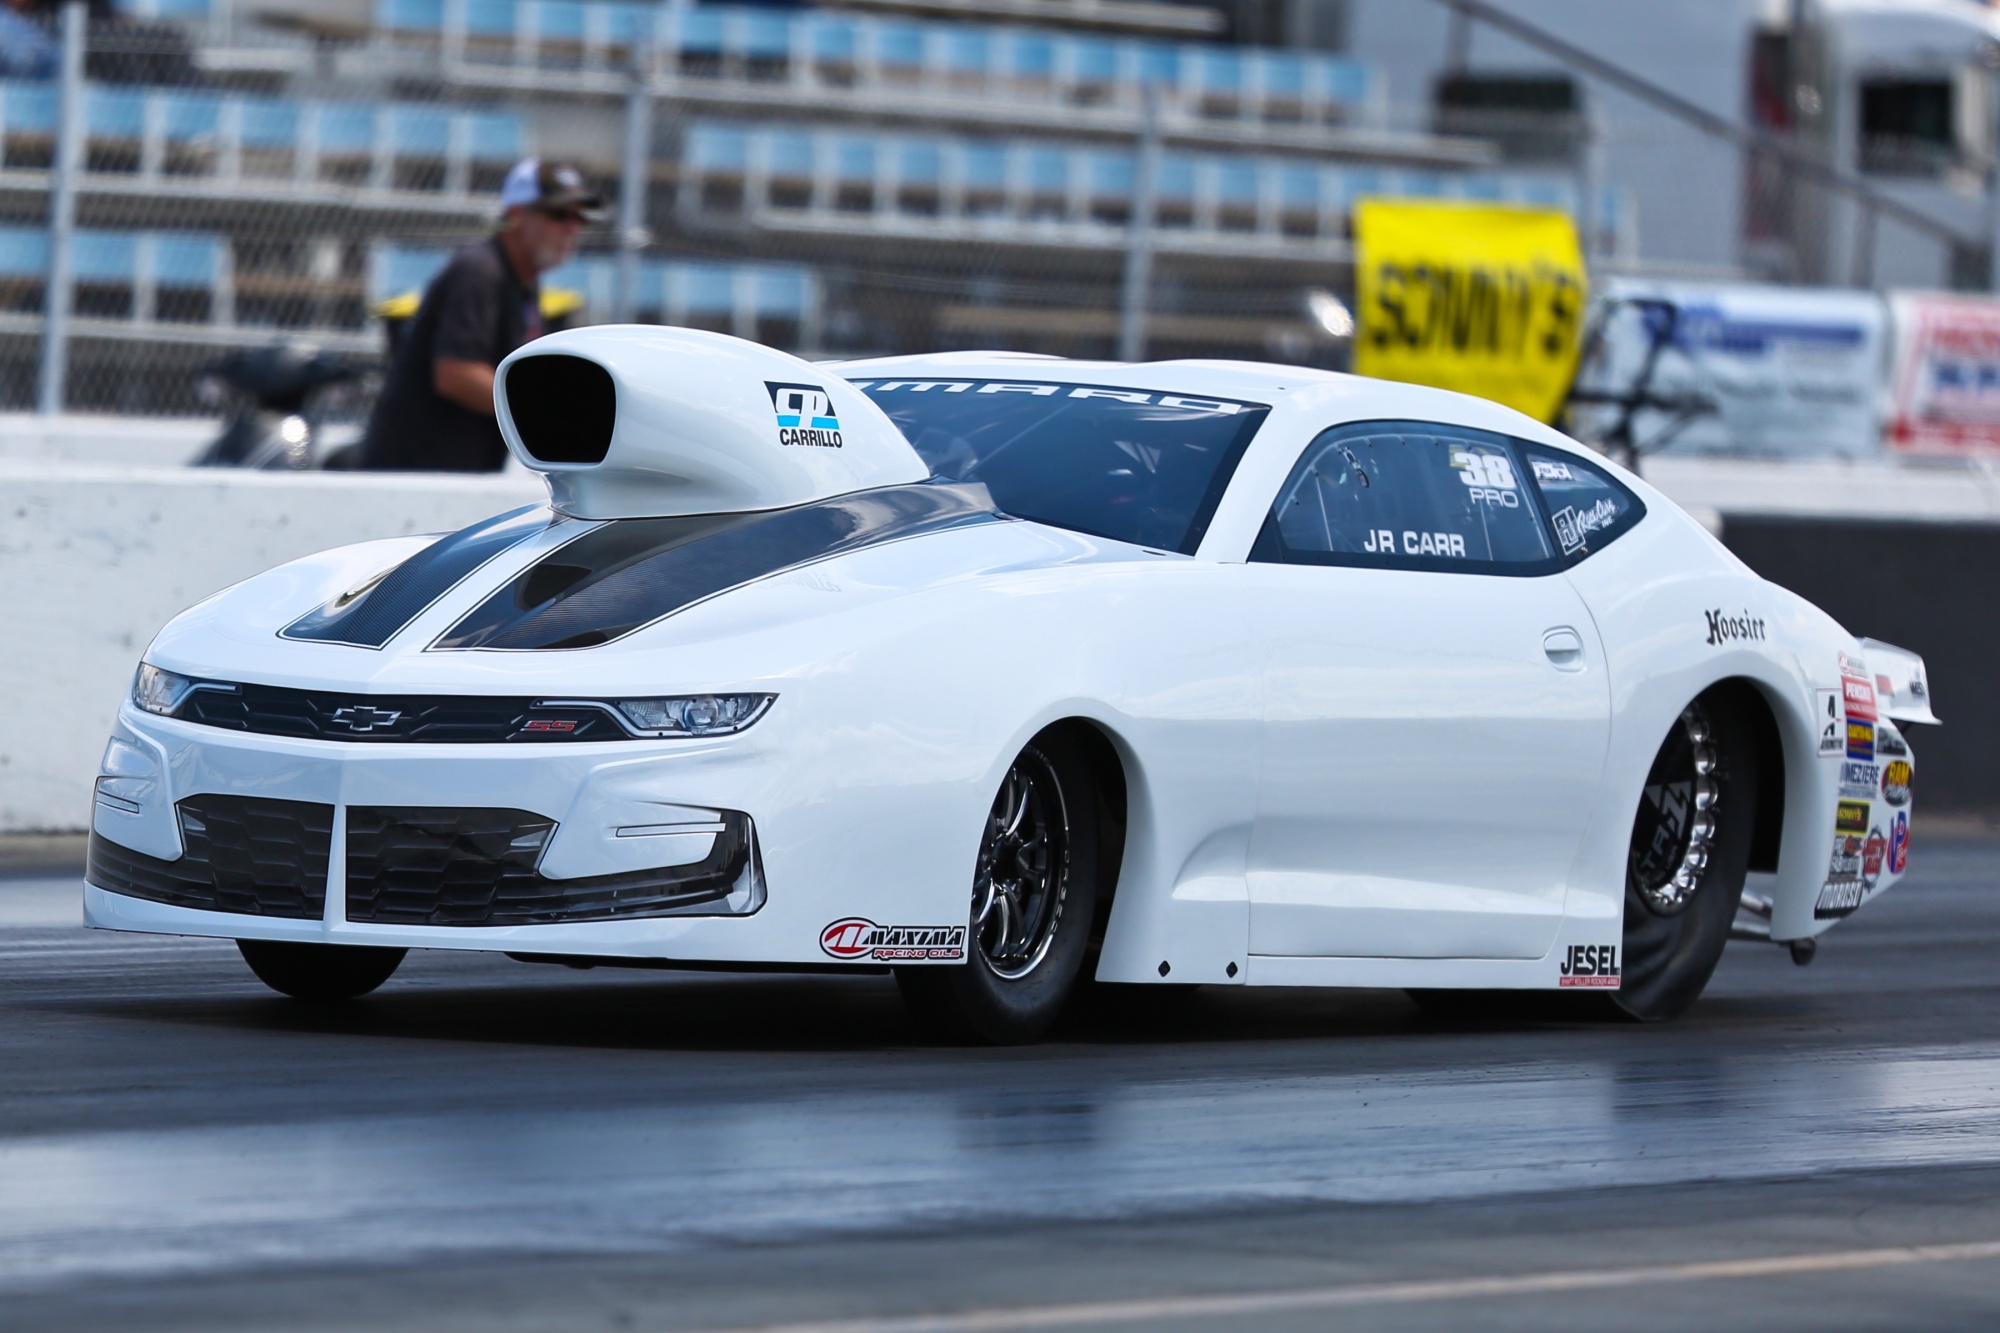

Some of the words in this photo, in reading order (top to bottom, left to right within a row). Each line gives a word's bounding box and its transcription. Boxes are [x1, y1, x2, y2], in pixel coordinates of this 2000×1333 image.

[780, 428, 843, 449] CARRILLO
[1454, 452, 1517, 489] 38
[1469, 487, 1519, 508] PRO
[1363, 529, 1395, 553] JR
[1402, 531, 1466, 557] CARR
[520, 720, 578, 732] SS
[1845, 763, 1880, 785] MEZIERE
[1888, 761, 1910, 785] RAM
[861, 930, 963, 946] MAXIMA
[1560, 945, 1620, 975] JESEL
